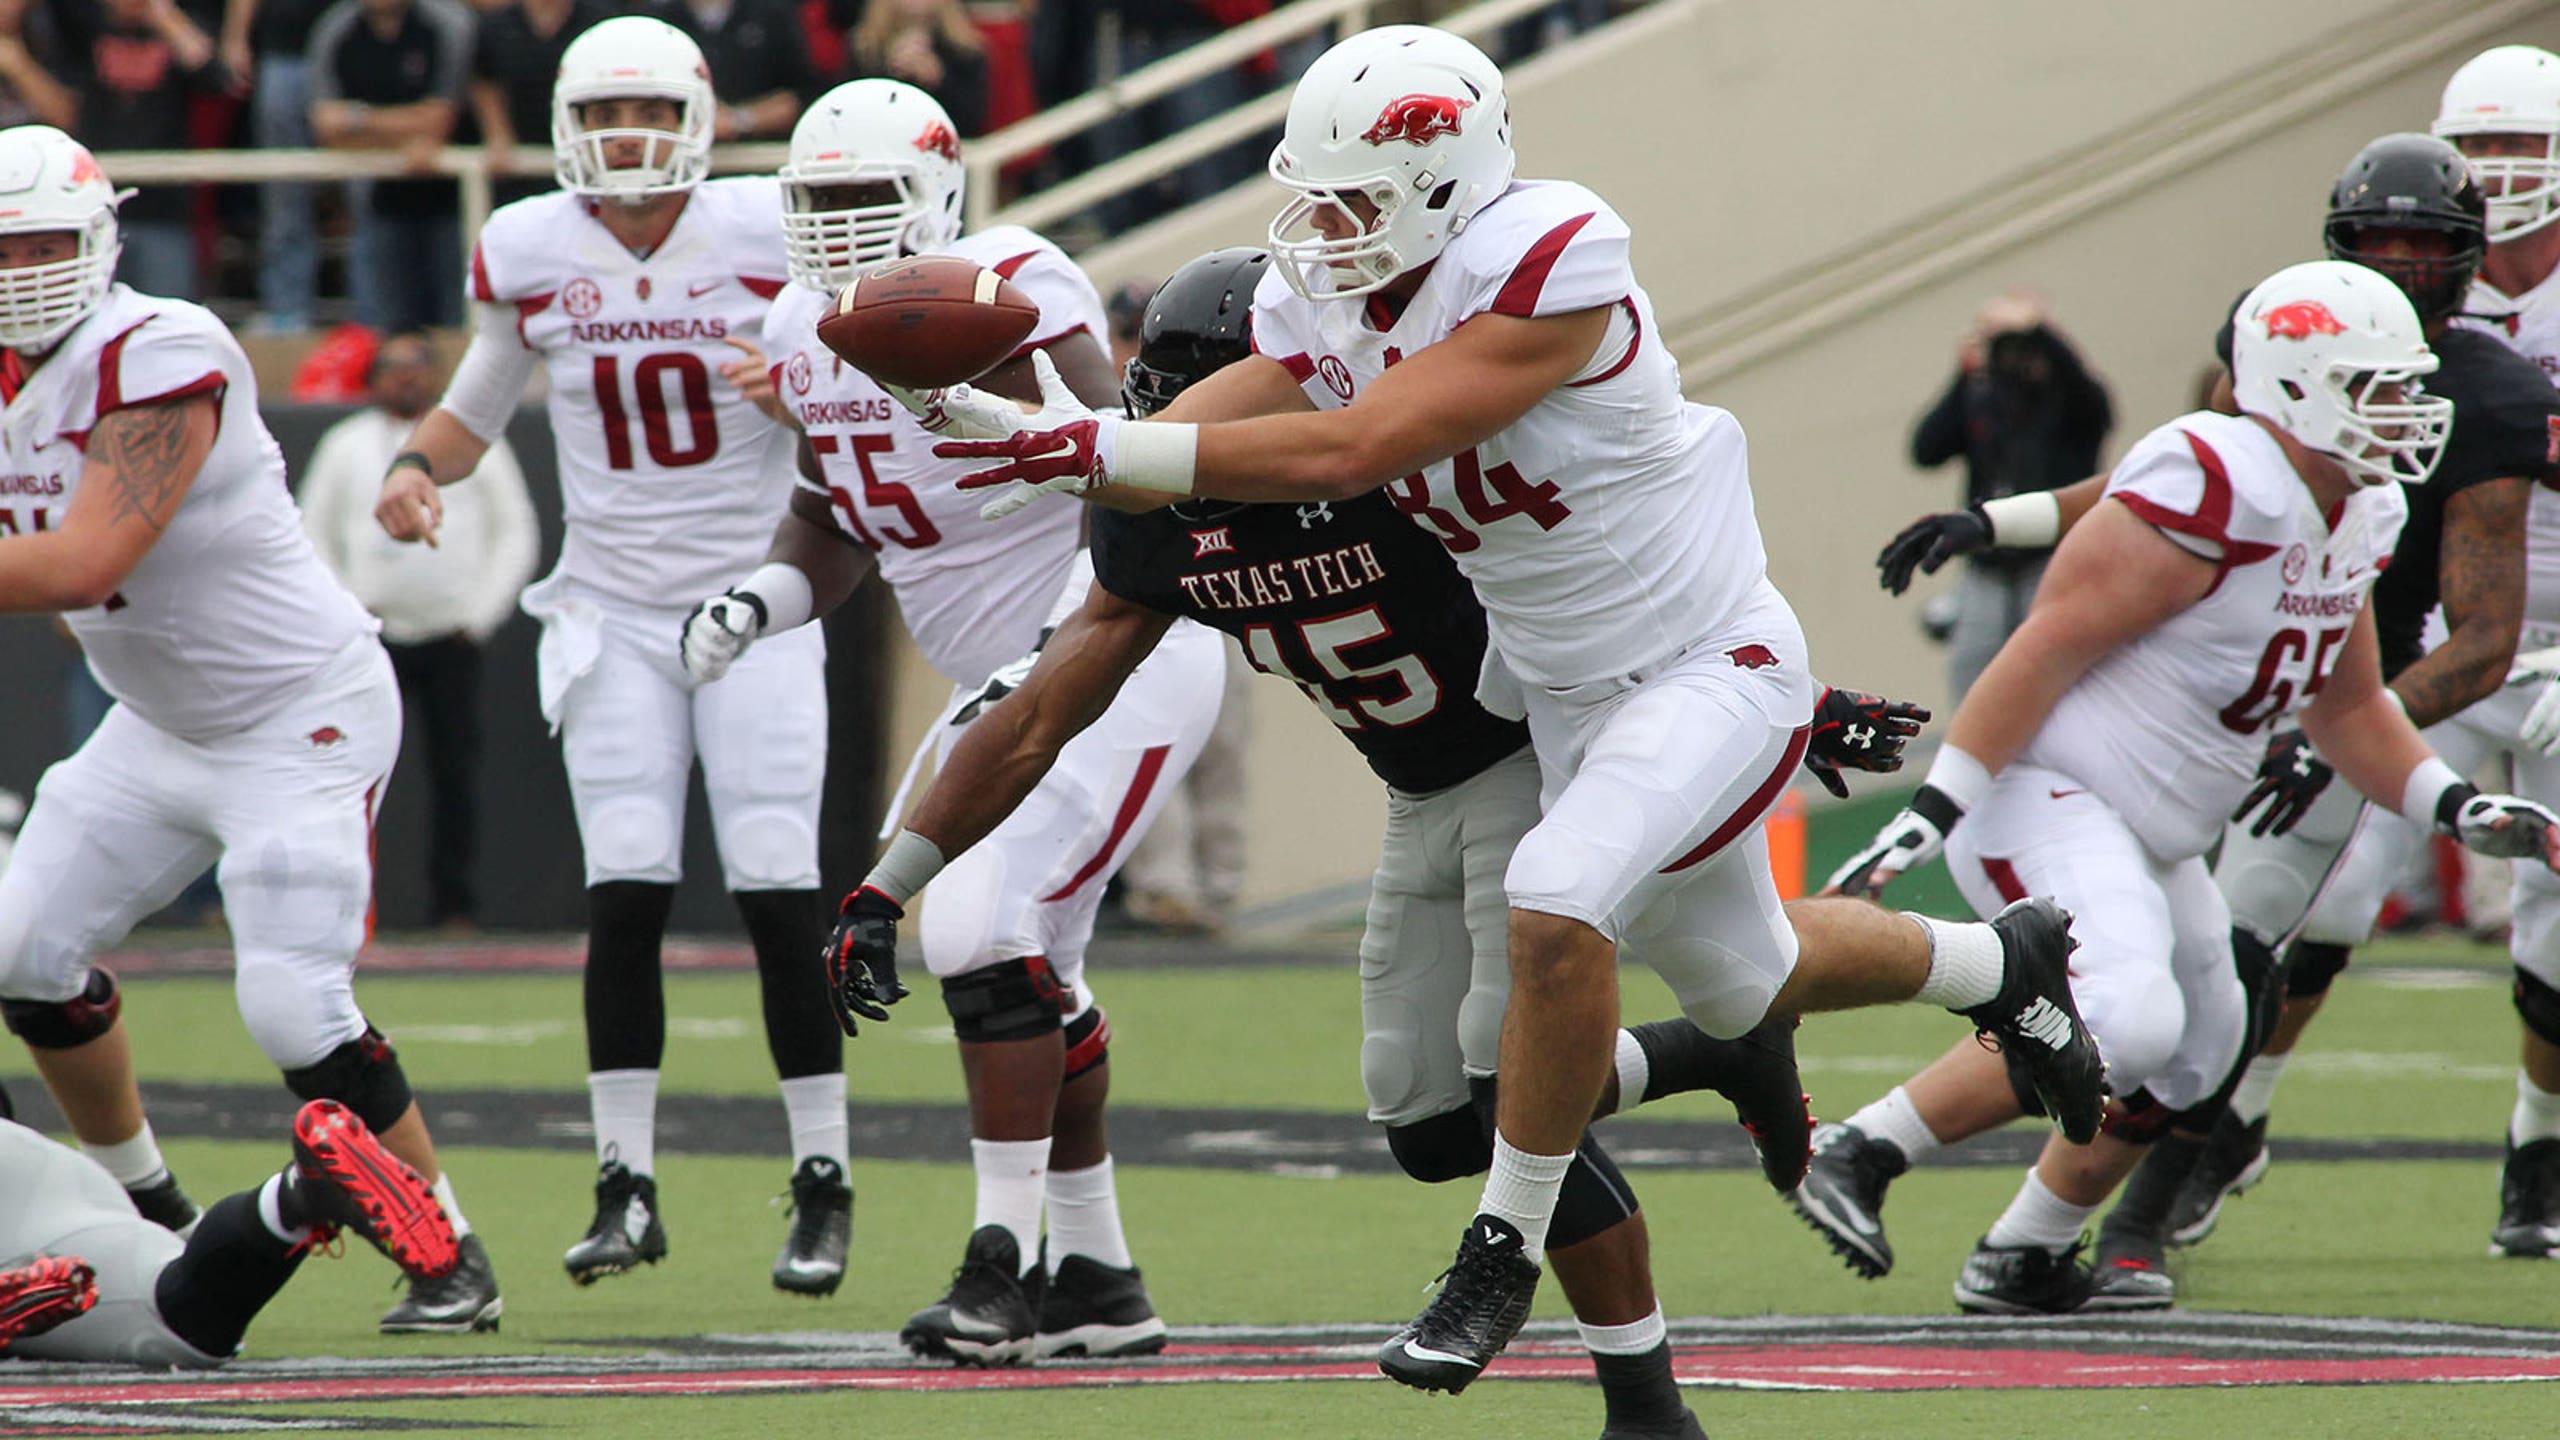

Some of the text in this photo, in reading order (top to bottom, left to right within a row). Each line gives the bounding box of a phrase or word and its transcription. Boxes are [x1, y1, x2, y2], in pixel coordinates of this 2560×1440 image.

[570, 319, 728, 342] ARKANSAS
[594, 352, 720, 470] 10
[800, 399, 892, 424] ARKANSAS
[811, 434, 942, 553] 55
[1384, 447, 1572, 554] 84
[1179, 541, 1387, 611] TEXAS TECH
[1245, 602, 1443, 731] 15
[2219, 628, 2348, 735] 65
